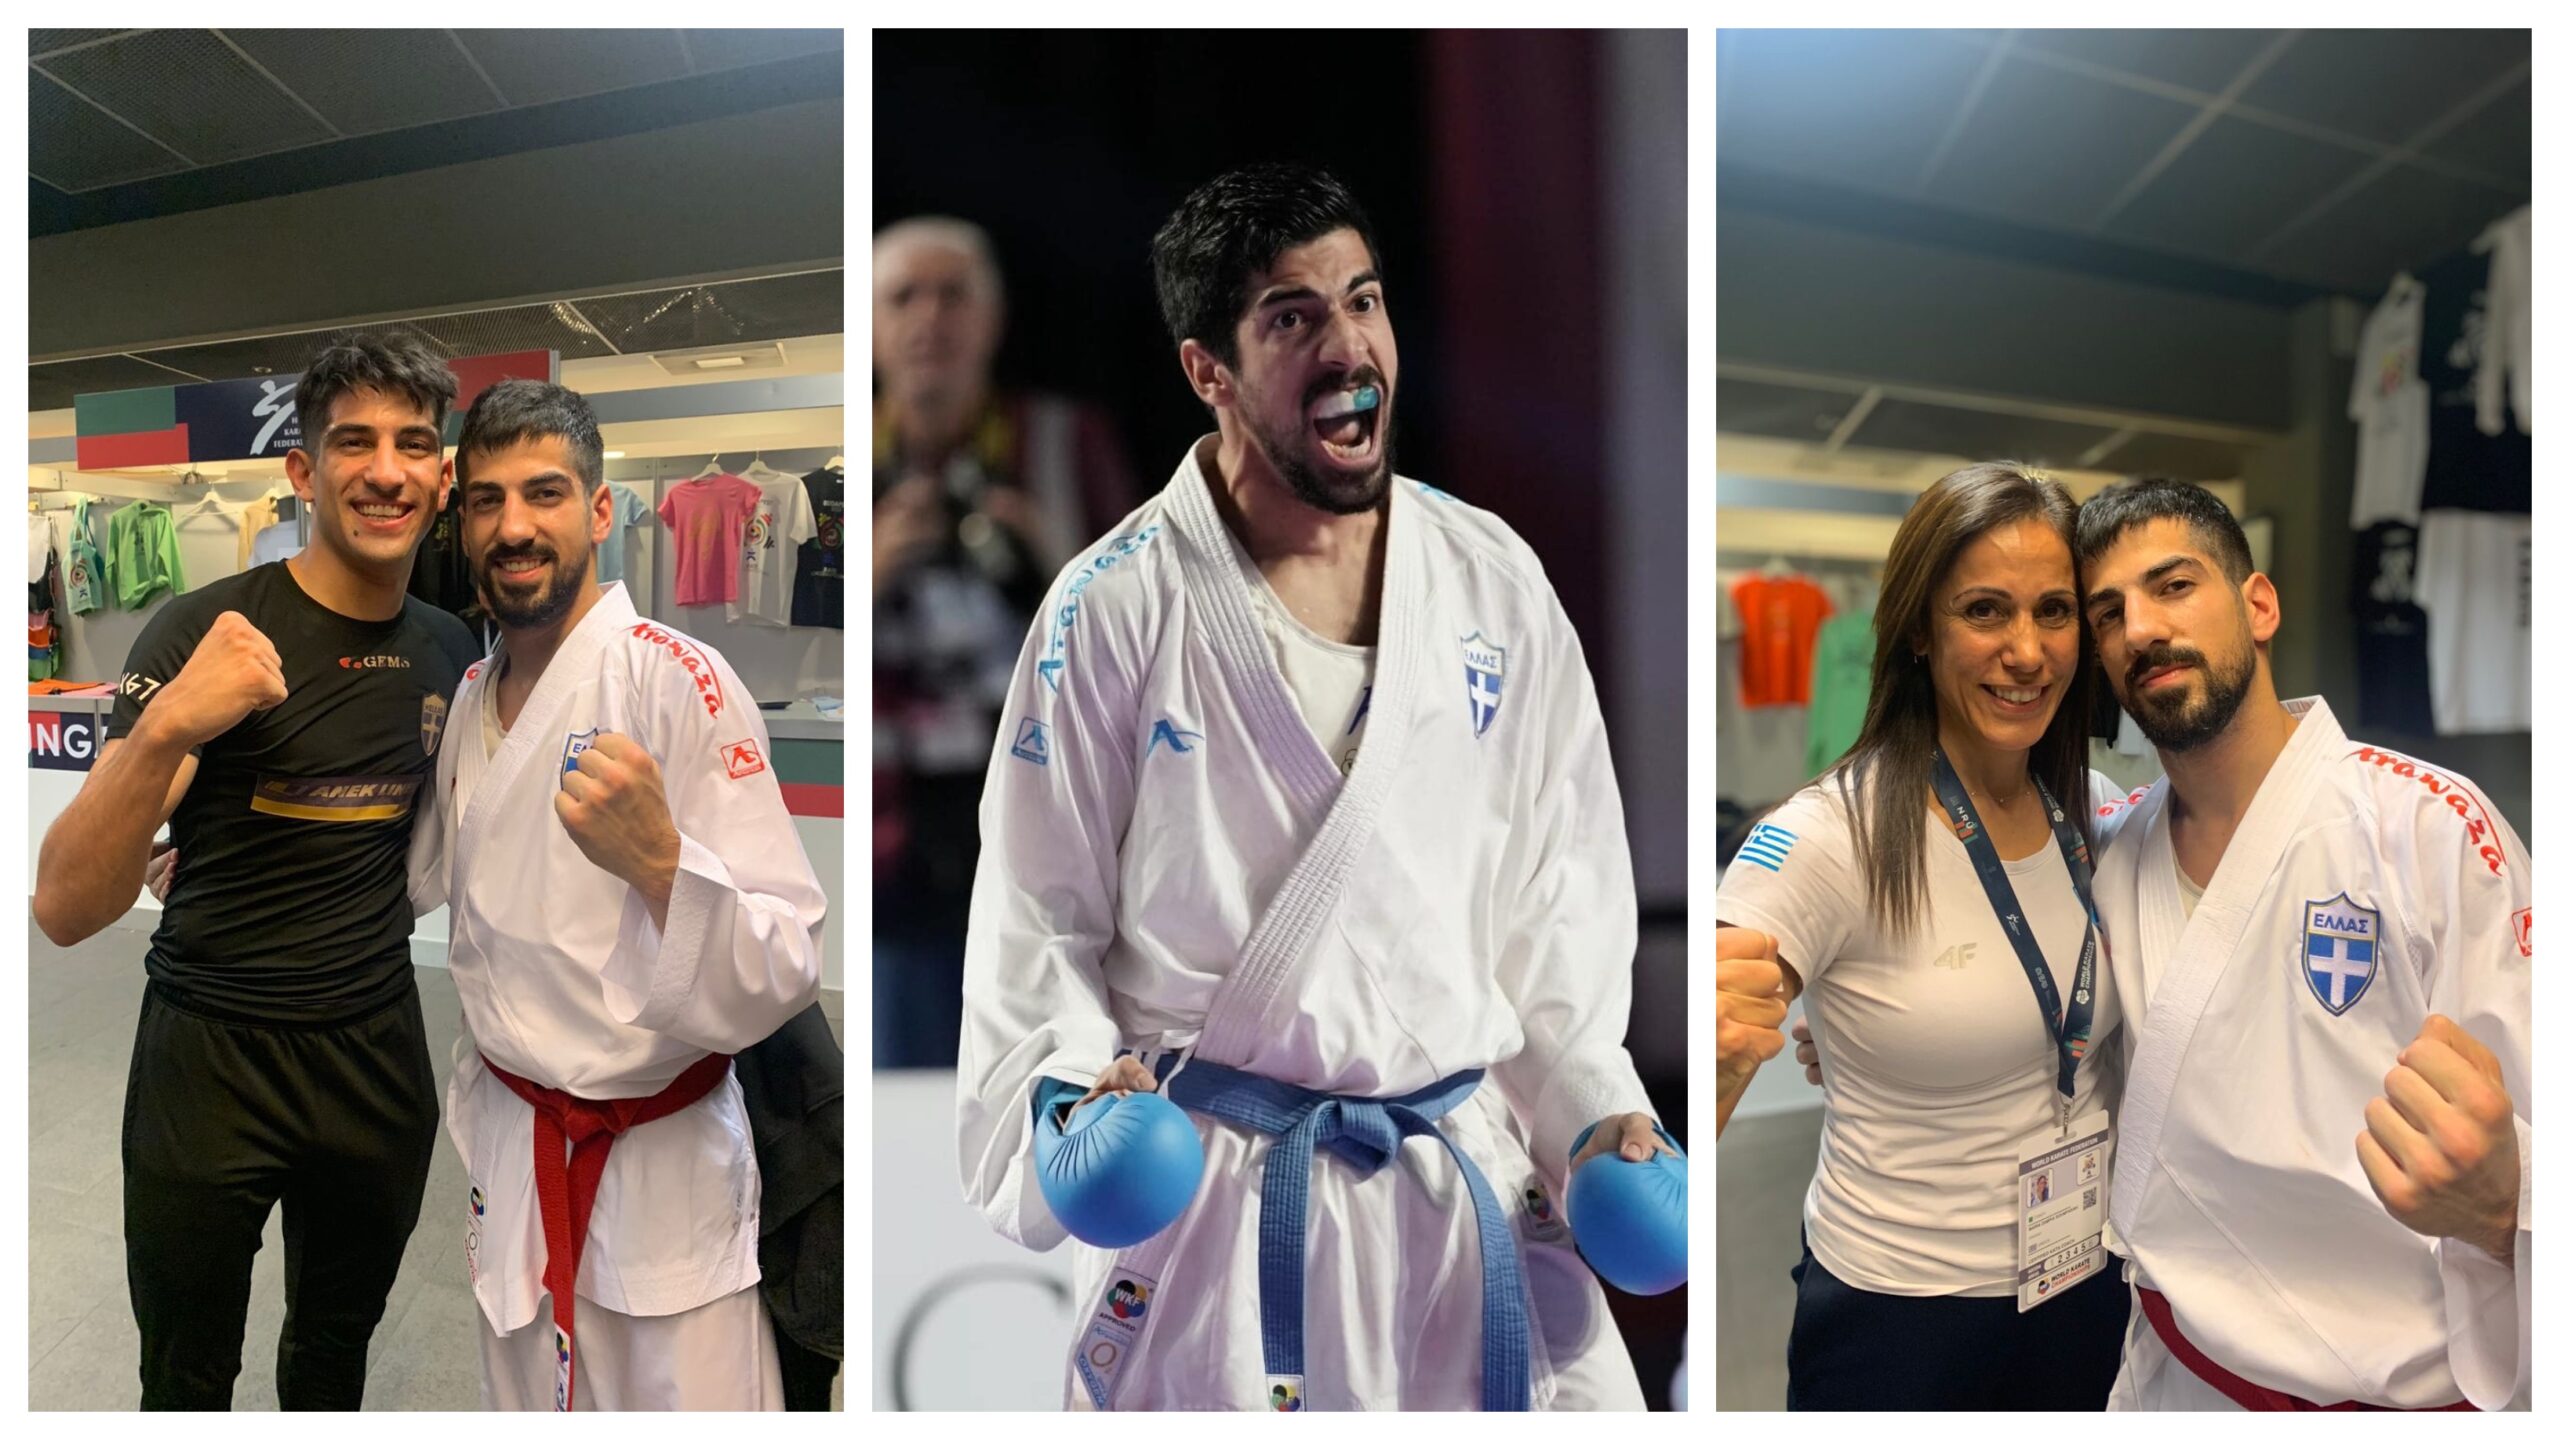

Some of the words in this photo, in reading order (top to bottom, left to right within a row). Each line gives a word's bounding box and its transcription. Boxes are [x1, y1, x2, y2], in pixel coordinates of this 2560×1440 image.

[284, 427, 301, 436] KAR
[28, 722, 108, 760] NG
[2313, 911, 2369, 934] ΕΛΛΑΣ
[1933, 942, 1977, 970] 4F
[1114, 1287, 1142, 1307] WKF
[1098, 1311, 1137, 1333] APPROVED
